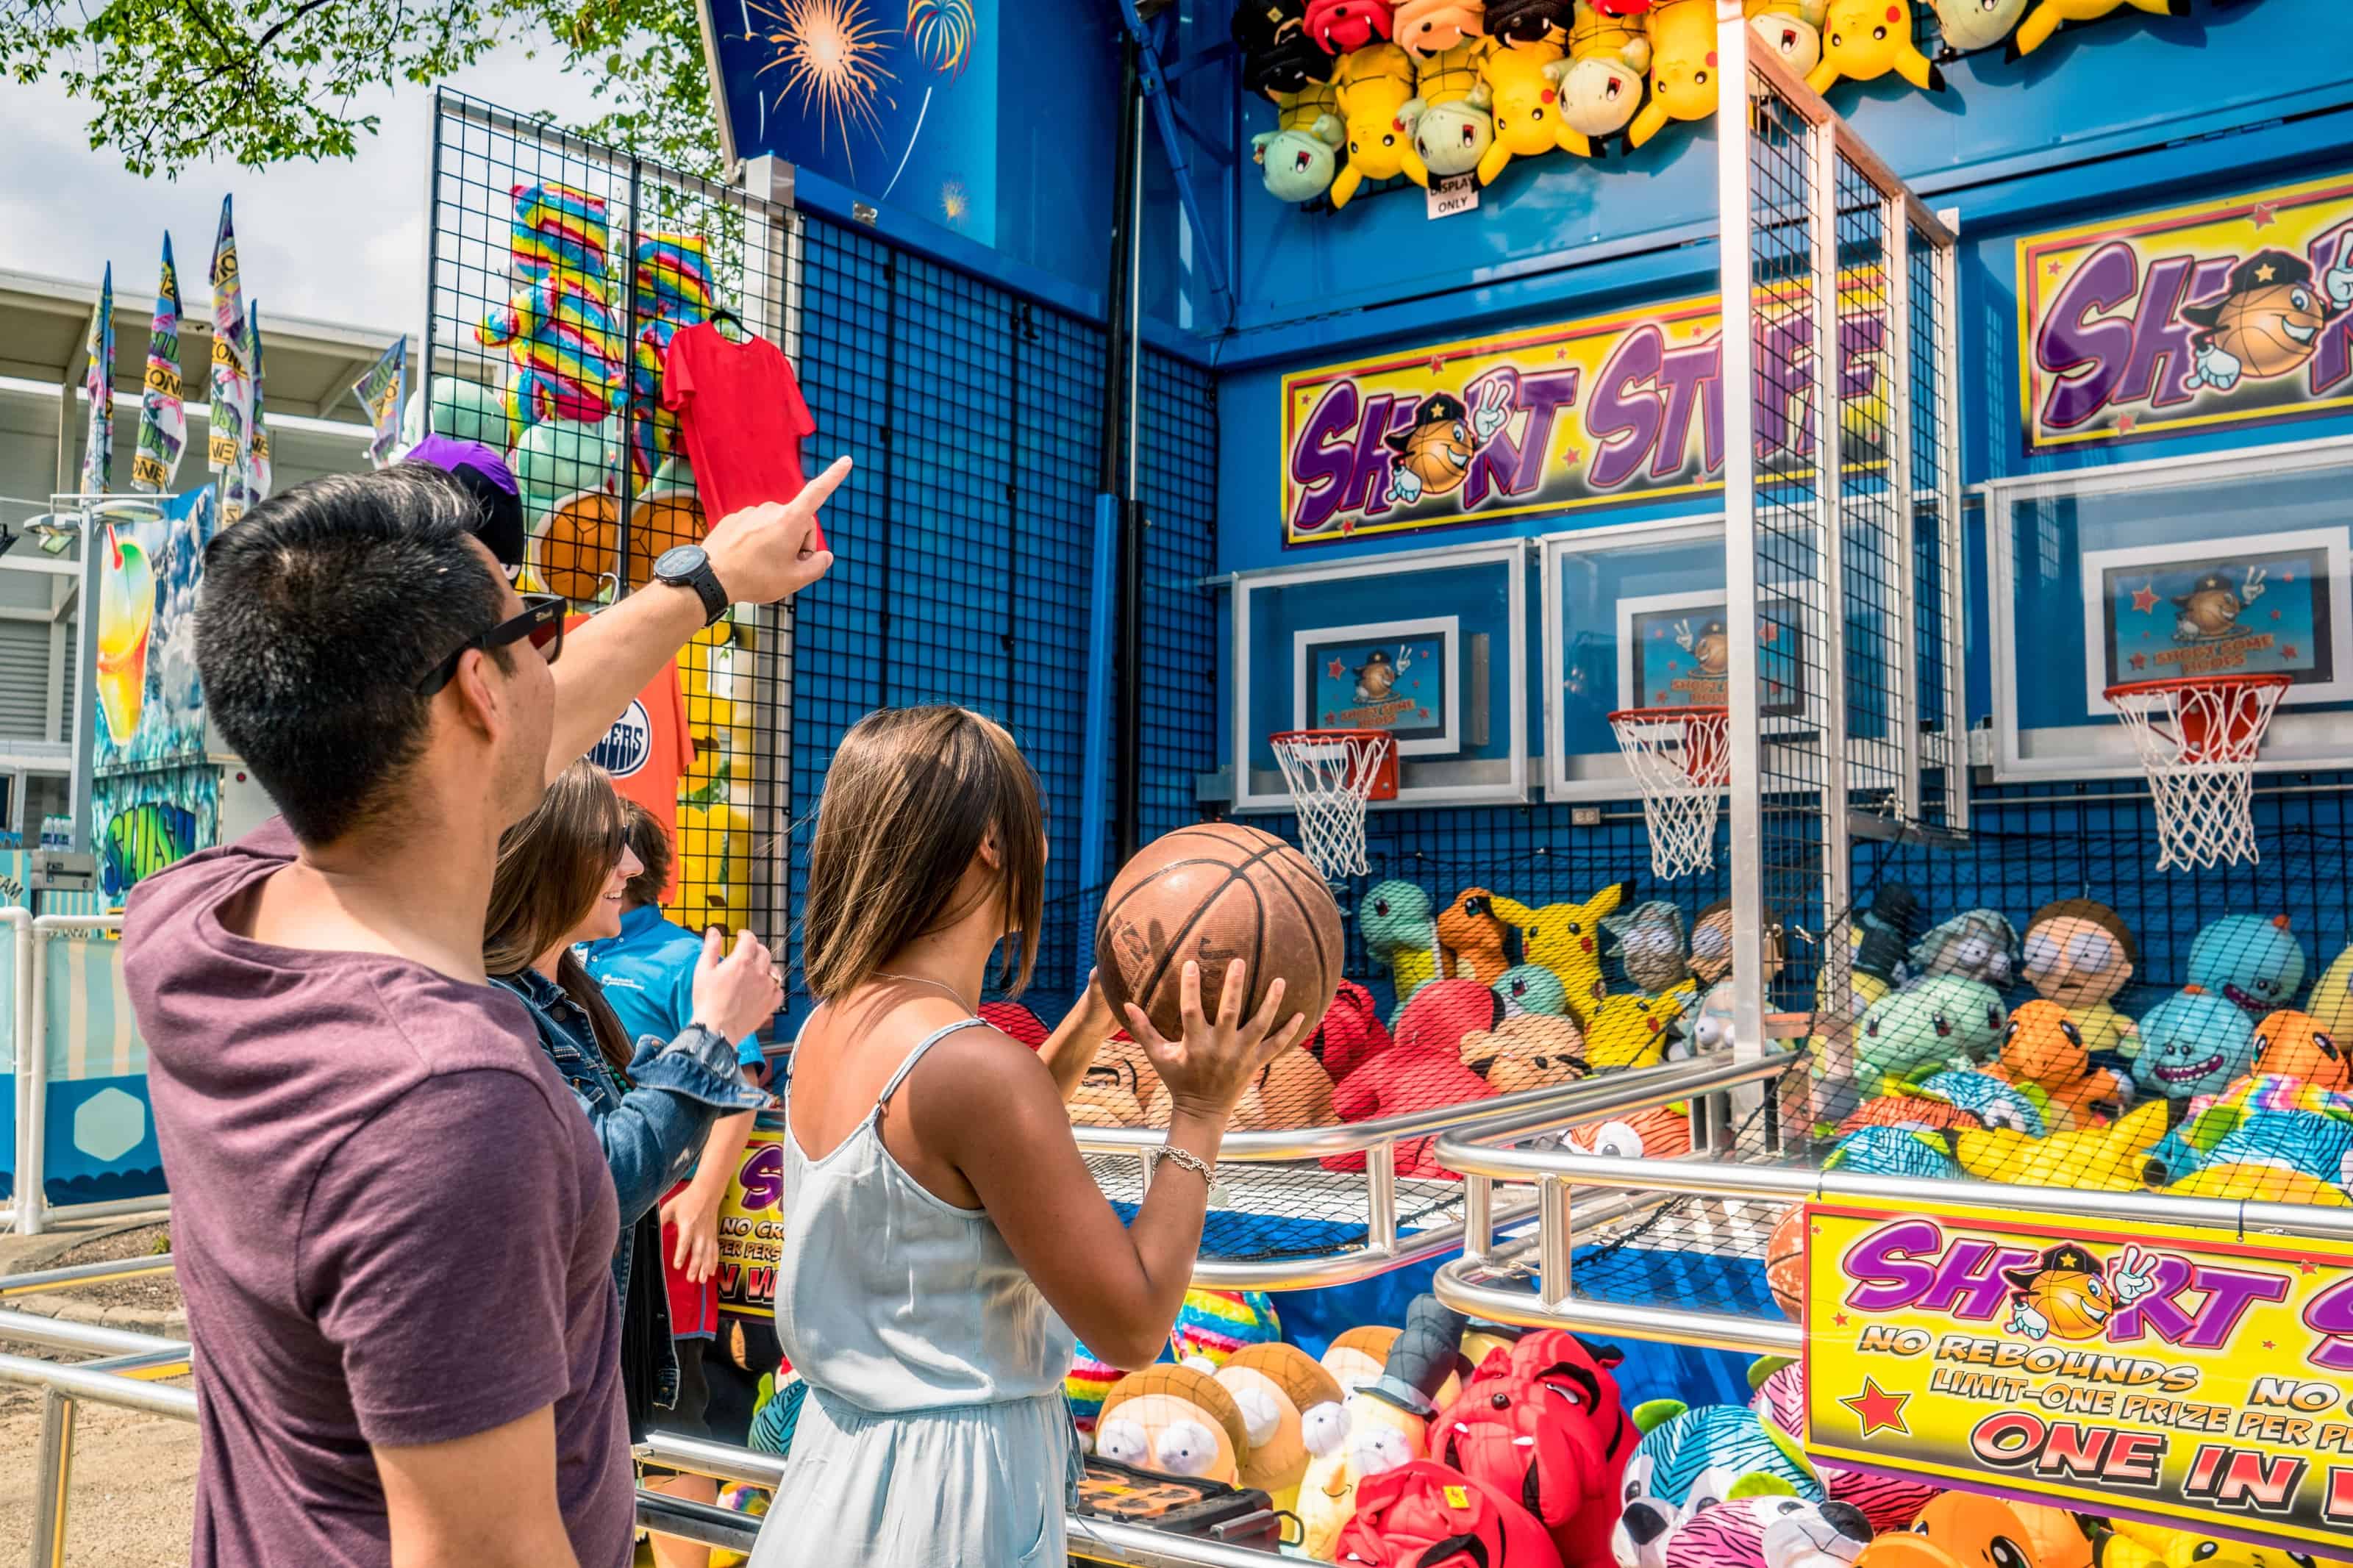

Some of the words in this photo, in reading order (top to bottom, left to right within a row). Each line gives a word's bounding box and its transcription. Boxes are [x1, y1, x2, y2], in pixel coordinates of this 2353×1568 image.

[1430, 176, 1474, 197] DSPLA
[1438, 196, 1468, 213] ONLY
[104, 801, 196, 897] SLUSH
[719, 1217, 753, 1237] NO
[755, 1220, 784, 1241] CR
[1857, 1325, 1932, 1357] NO
[1934, 1335, 2199, 1393] REBOUNDS
[2247, 1377, 2340, 1413] NO
[1929, 1368, 2116, 1416] LIMIT-ONE
[2119, 1395, 2231, 1433] PRIZE
[2235, 1411, 2313, 1445] PER
[1971, 1411, 2168, 1487] ONE
[2183, 1443, 2310, 1511] IN
